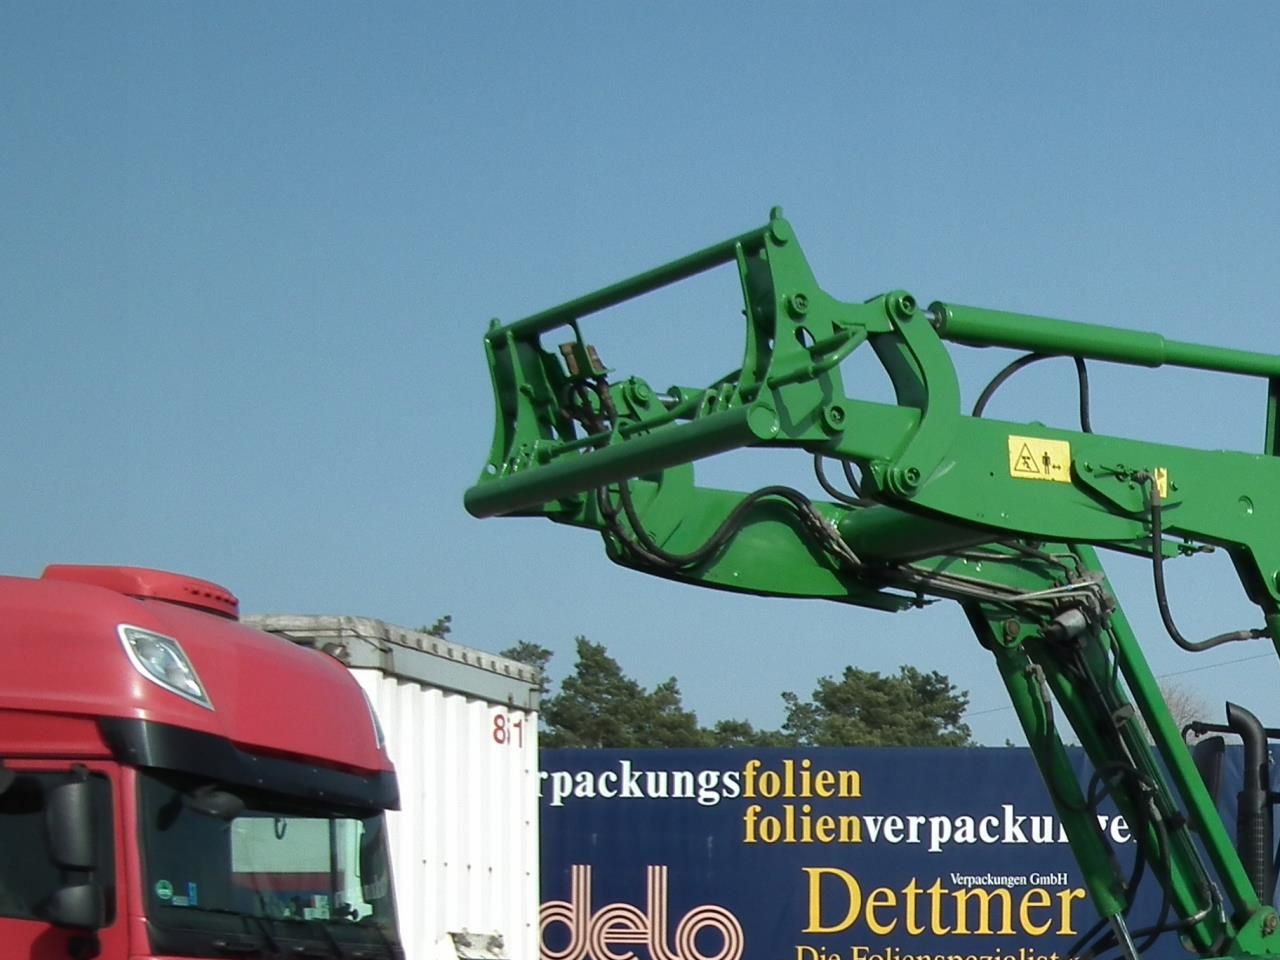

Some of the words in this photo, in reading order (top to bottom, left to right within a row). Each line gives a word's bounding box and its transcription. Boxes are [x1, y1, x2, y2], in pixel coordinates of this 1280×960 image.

[742, 803, 1139, 853] folienverpackue
[801, 866, 1087, 936] Dettmer
[950, 872, 1027, 888] Verpackungen
[1029, 872, 1069, 886] GmbH
